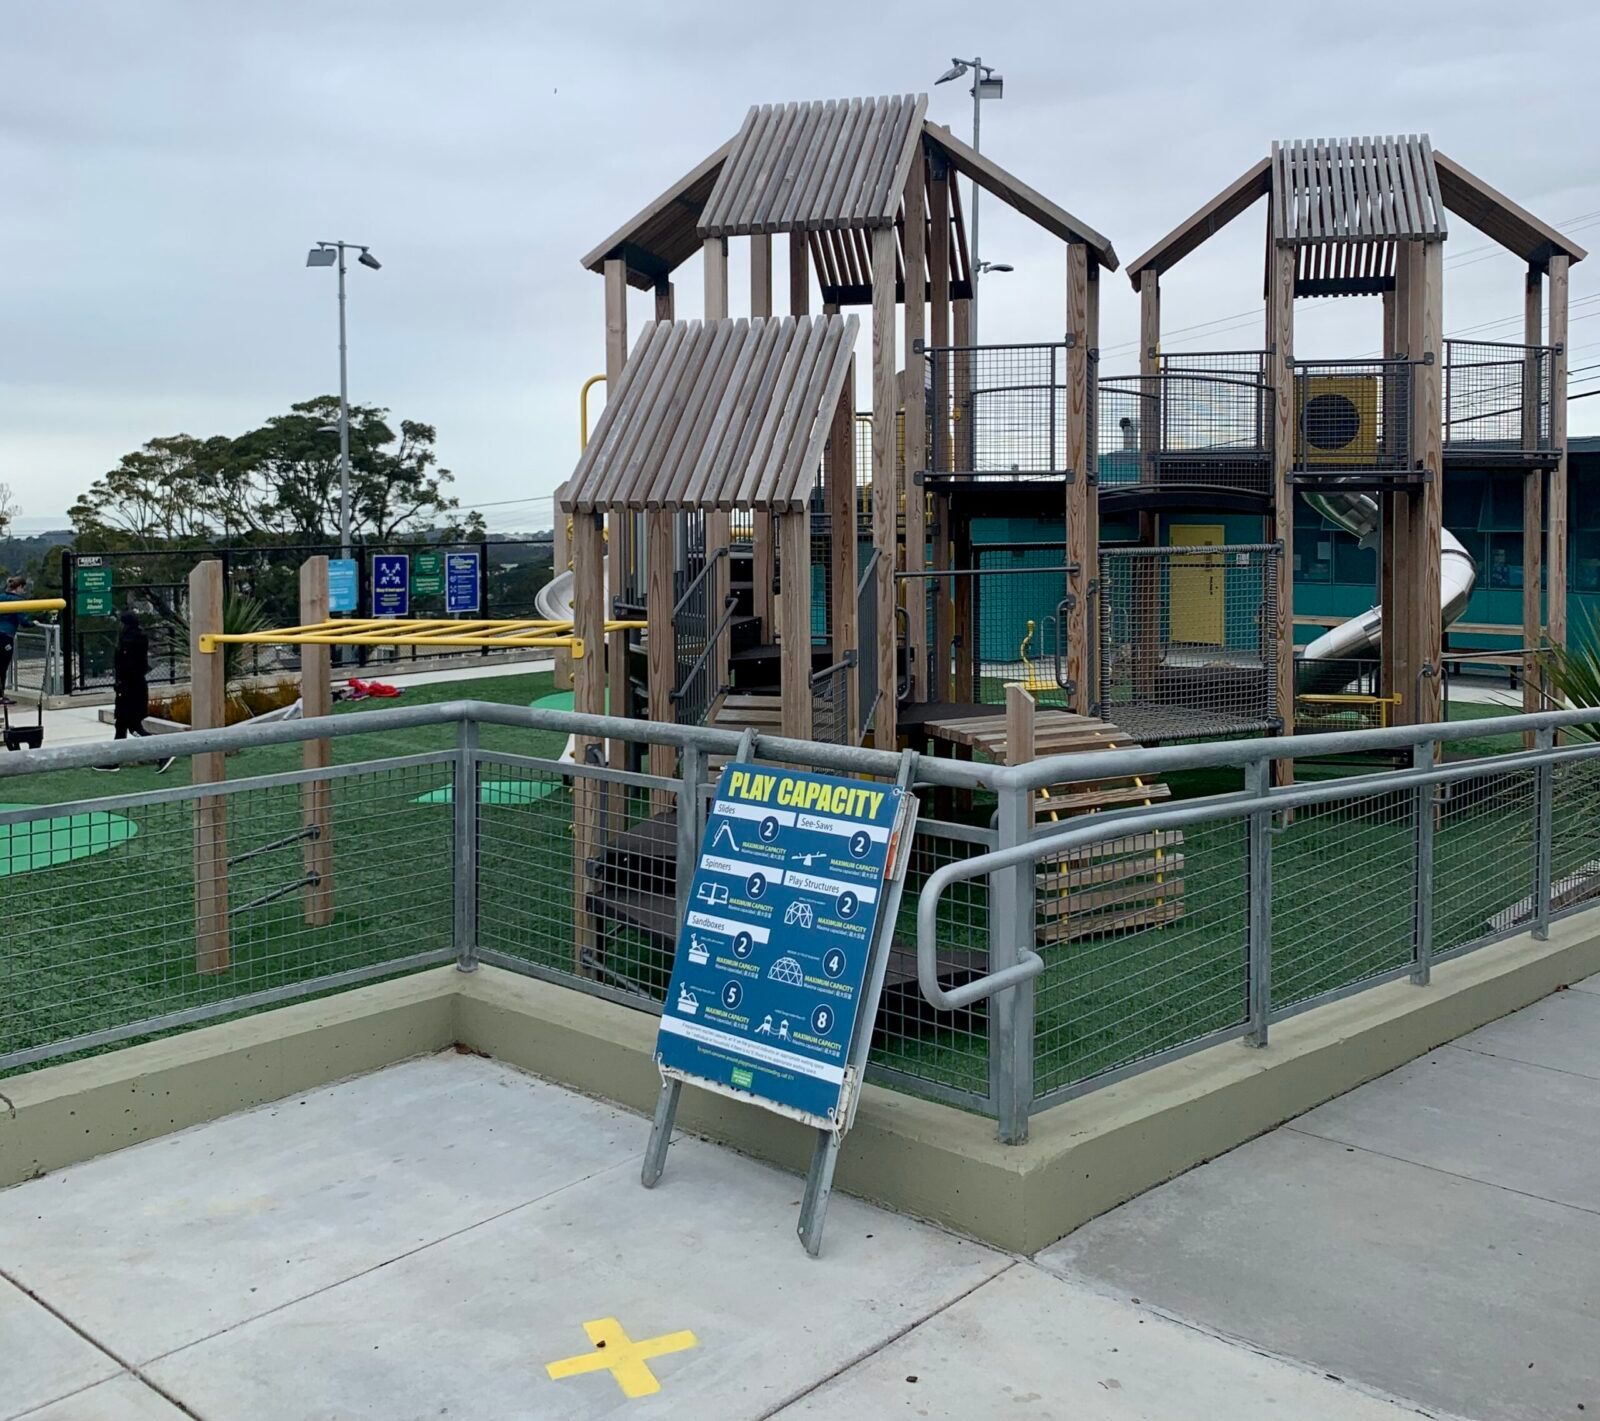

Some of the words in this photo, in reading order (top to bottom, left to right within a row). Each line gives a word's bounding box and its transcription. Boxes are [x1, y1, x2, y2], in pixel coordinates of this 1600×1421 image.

[728, 771, 776, 803] PLAY
[777, 777, 884, 820] CAPACITY
[718, 803, 735, 815] Slides
[764, 822, 773, 836] 2
[801, 817, 833, 831] See-Saws
[742, 841, 765, 851] MAXIMUM
[765, 845, 786, 854] CAPACITY
[854, 837, 865, 852] 2
[705, 859, 731, 872] Spinners
[830, 858, 855, 869] MAXIMUM
[856, 862, 879, 873] CAPACITY
[751, 879, 760, 893] 2
[789, 875, 803, 886] Play
[804, 880, 840, 893] Structures
[729, 897, 752, 908] MAXIMUM
[752, 901, 773, 912] CAPACITY
[842, 898, 851, 913] 2
[692, 915, 725, 931] Sandboxes
[818, 916, 843, 928] MAXIMUM
[843, 922, 866, 933] CAPACITY
[738, 937, 748, 952] 2
[716, 955, 739, 967] MAXIMUM
[739, 961, 760, 973] CAPACITY
[829, 956, 839, 972] 4
[804, 974, 830, 987] MAXIMUM
[830, 981, 854, 993] CAPACITY
[727, 987, 737, 1003] 5
[705, 1005, 728, 1018] MAXIMUM
[729, 1012, 749, 1024] CAPACITY
[817, 1011, 828, 1028] 8
[793, 1030, 818, 1044] MAXIMUM
[819, 1037, 842, 1051] CAPACITY
